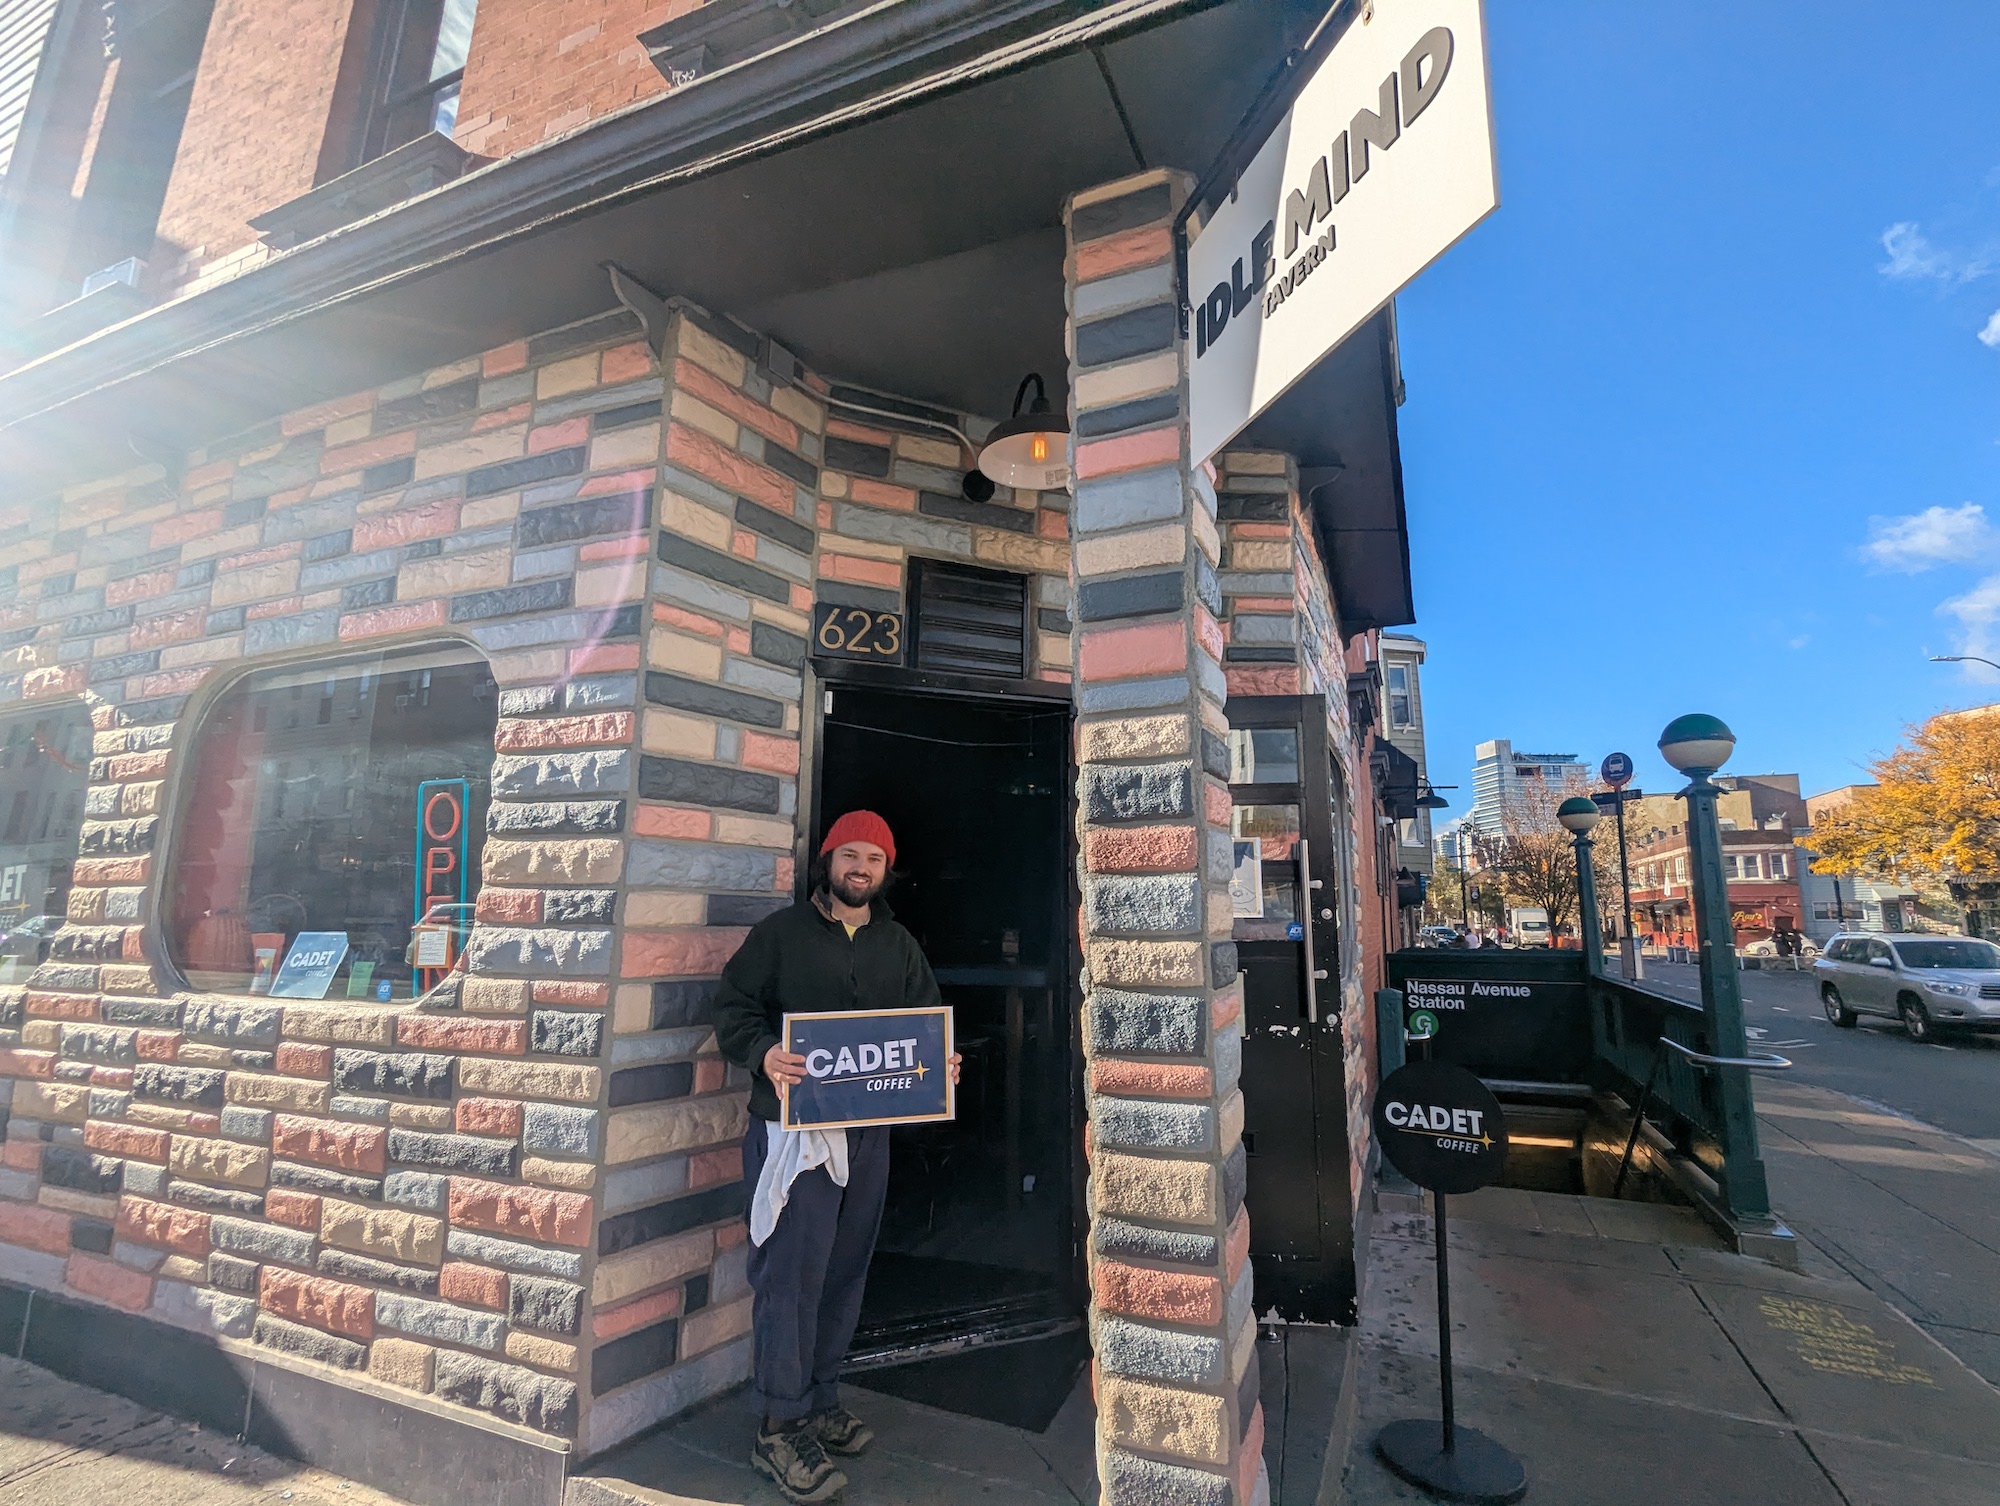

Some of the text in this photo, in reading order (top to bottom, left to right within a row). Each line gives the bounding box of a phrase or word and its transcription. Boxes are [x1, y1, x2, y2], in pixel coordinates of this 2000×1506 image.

[1196, 26, 1454, 359] IDLE MIND
[1261, 224, 1337, 319] TAVERN
[818, 607, 901, 656] 623
[0, 863, 28, 902] ET
[1730, 910, 1763, 922] Ray's
[1289, 926, 1302, 934] ADT
[289, 950, 337, 968] CADET
[1406, 980, 1531, 998] Nassau Avenue
[1407, 995, 1466, 1010] Station
[1415, 1014, 1433, 1032] G
[806, 1038, 917, 1077] CADET
[866, 1077, 913, 1092] COFFEE
[1385, 1102, 1483, 1135] CADET
[1436, 1137, 1480, 1155] COFFEE
